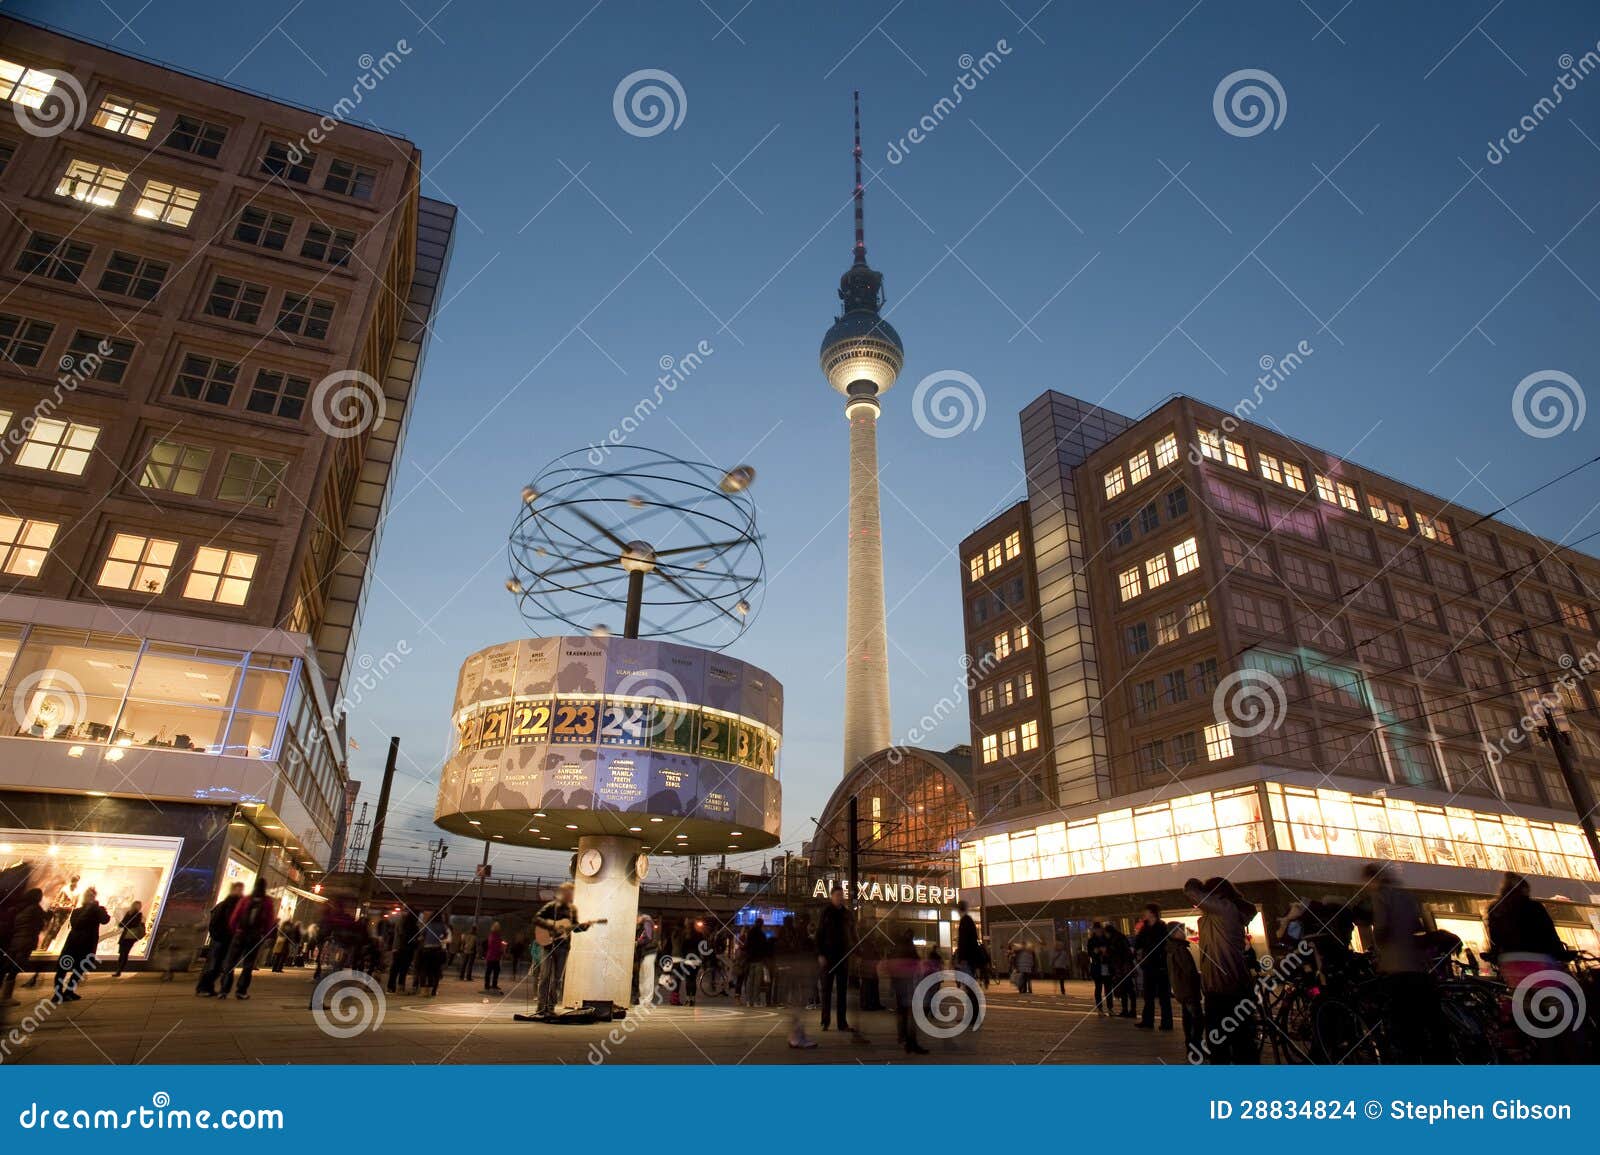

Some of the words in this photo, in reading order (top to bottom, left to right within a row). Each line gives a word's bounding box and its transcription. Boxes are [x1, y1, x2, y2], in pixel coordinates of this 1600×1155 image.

[483, 711, 508, 740] 21
[513, 707, 550, 735] 22
[554, 706, 595, 735] 23
[601, 707, 643, 737] 24
[701, 721, 719, 750] 2
[738, 730, 749, 758] 3
